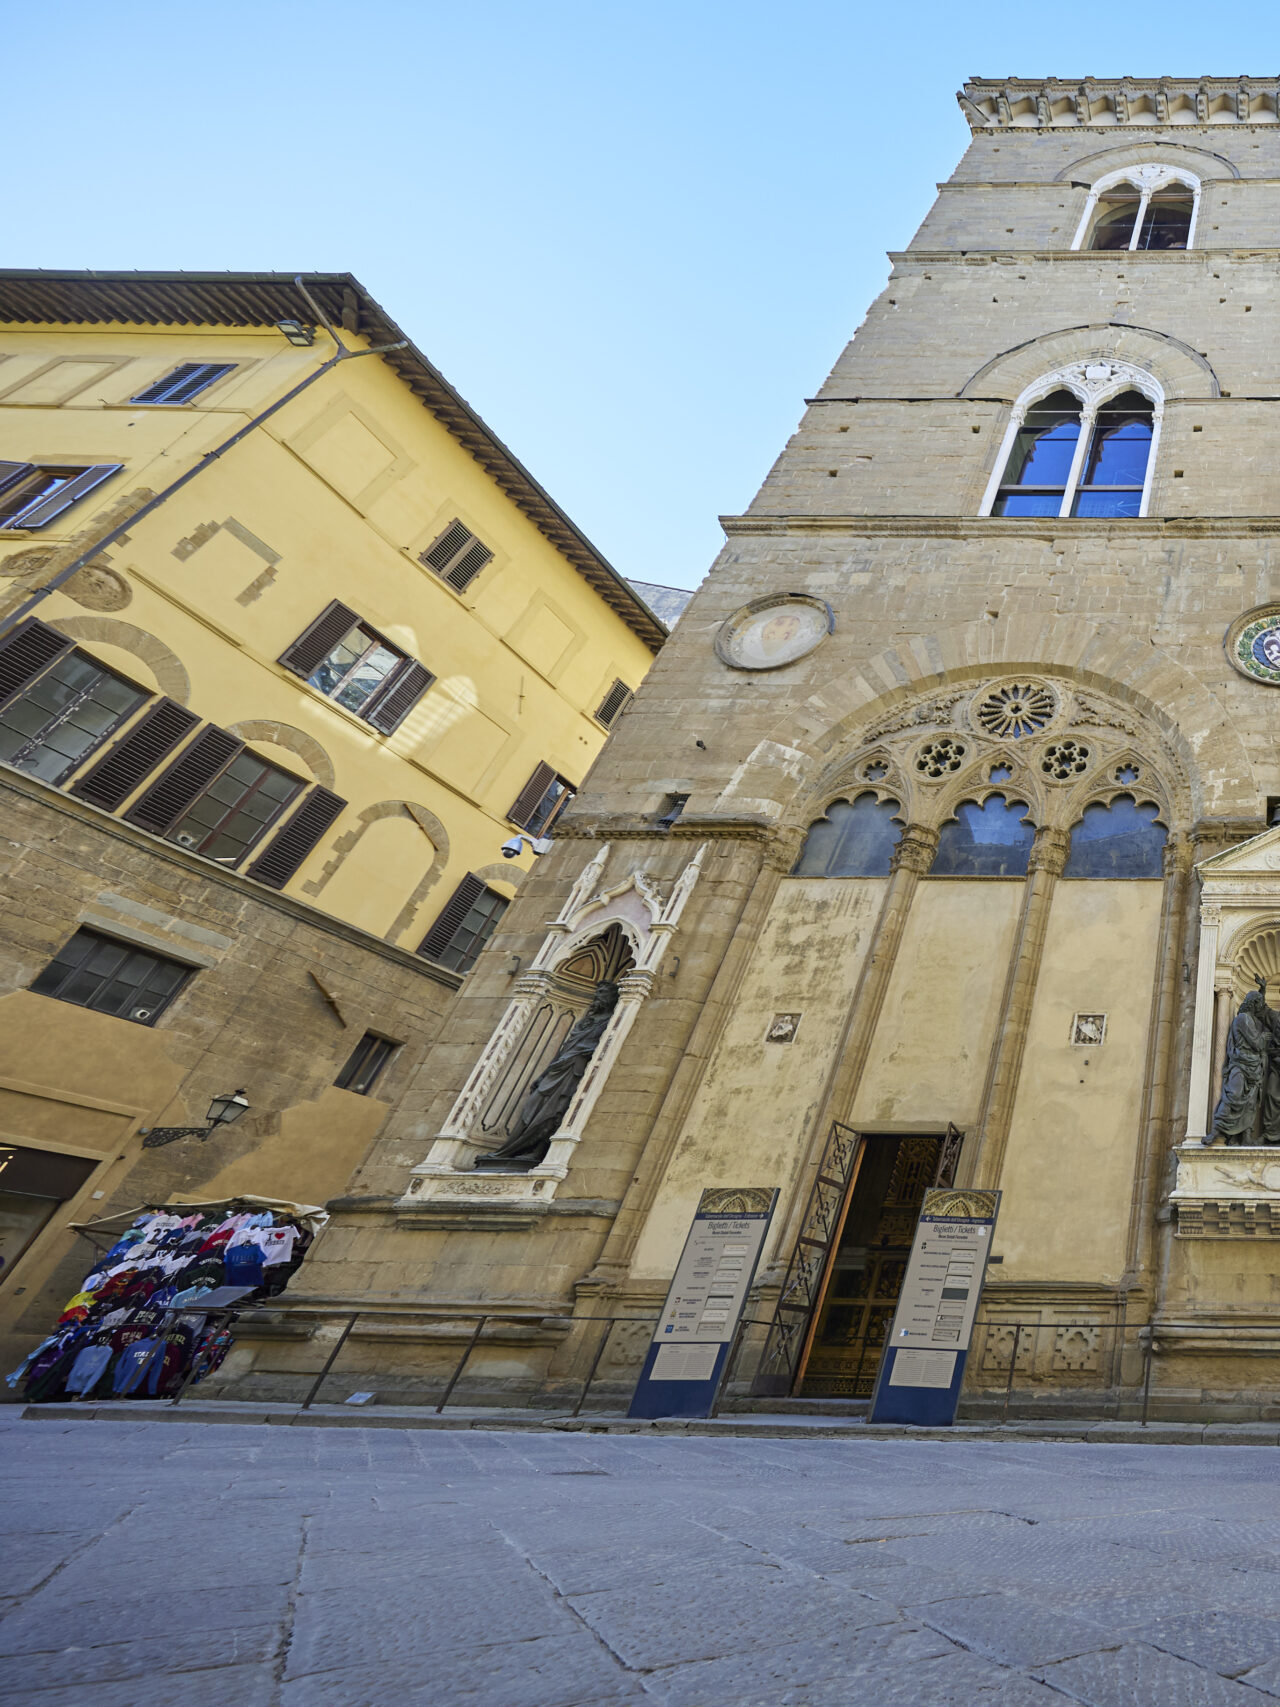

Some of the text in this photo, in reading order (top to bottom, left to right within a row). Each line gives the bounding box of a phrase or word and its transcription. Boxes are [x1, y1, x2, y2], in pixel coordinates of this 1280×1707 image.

[707, 1221, 728, 1231] Biglietti
[732, 1221, 751, 1230] Tickets
[933, 1224, 953, 1234] Biglietti
[957, 1225, 976, 1234] Tickets
